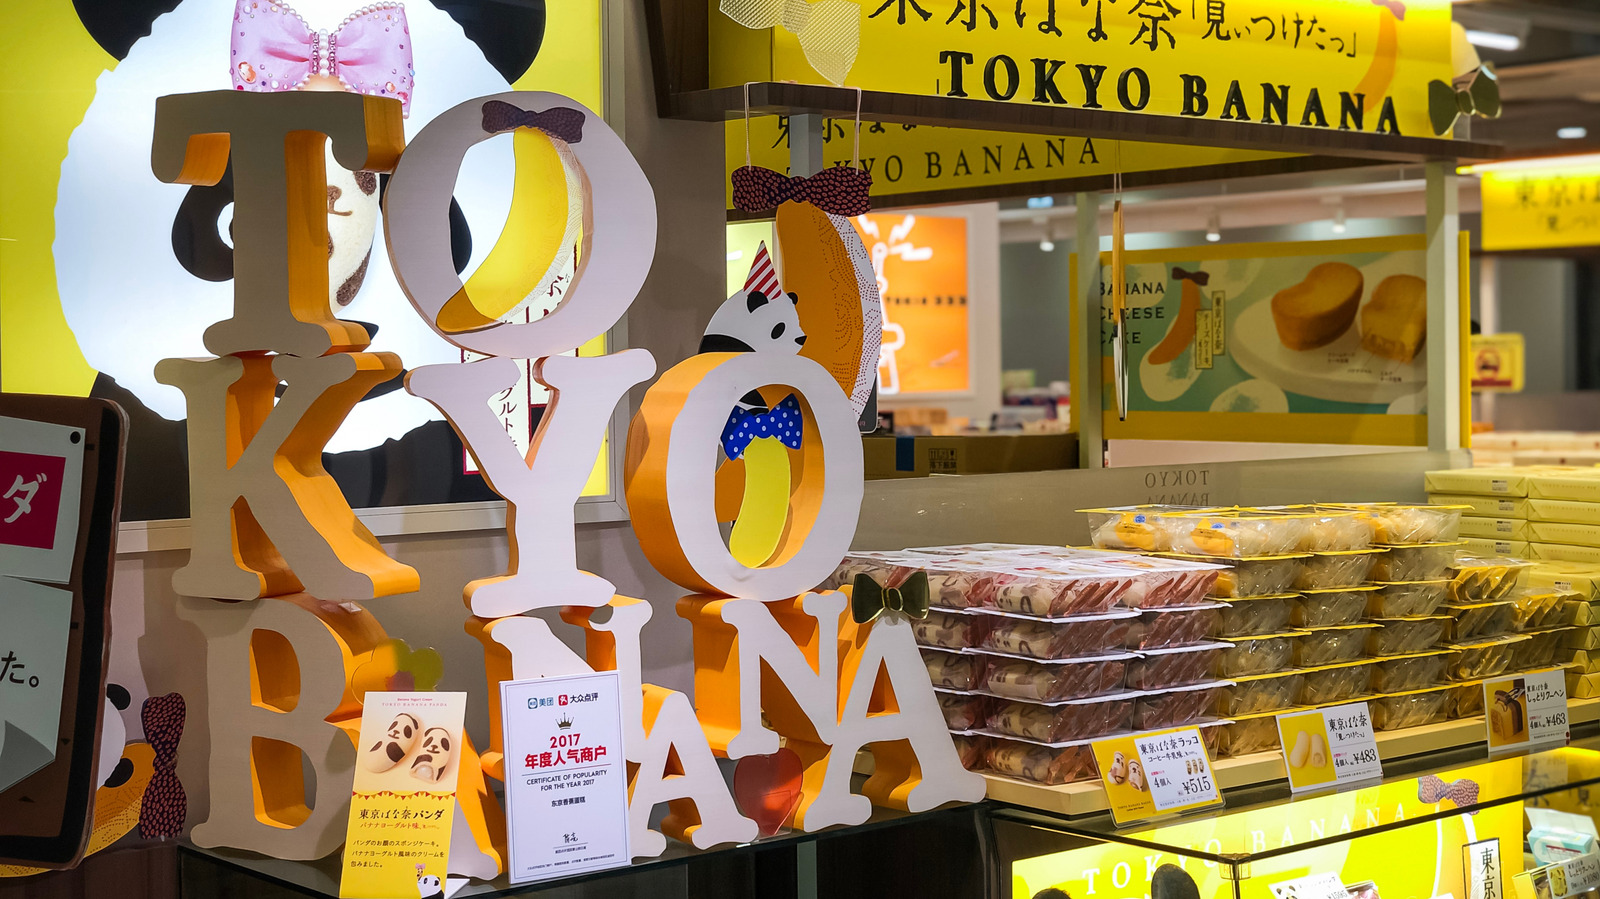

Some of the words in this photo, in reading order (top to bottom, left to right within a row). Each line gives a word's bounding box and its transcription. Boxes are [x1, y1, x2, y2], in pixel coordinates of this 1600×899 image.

[938, 50, 1152, 111] TOKYO
[1179, 73, 1401, 136] BANANA
[924, 136, 1100, 180] BANANA
[3, 472, 48, 523] ダ
[539, 697, 554, 707] 美团
[570, 692, 599, 703] 大众点评
[1545, 712, 1566, 727] ¥463
[550, 733, 581, 749] 2017
[525, 745, 607, 769] 年度人气商户
[1353, 748, 1377, 765] ¥483
[526, 775, 561, 785] CERTIFICATE
[572, 769, 608, 779] POPULARITY
[1182, 776, 1211, 795] ¥515
[1251, 802, 1405, 853] BANANA
